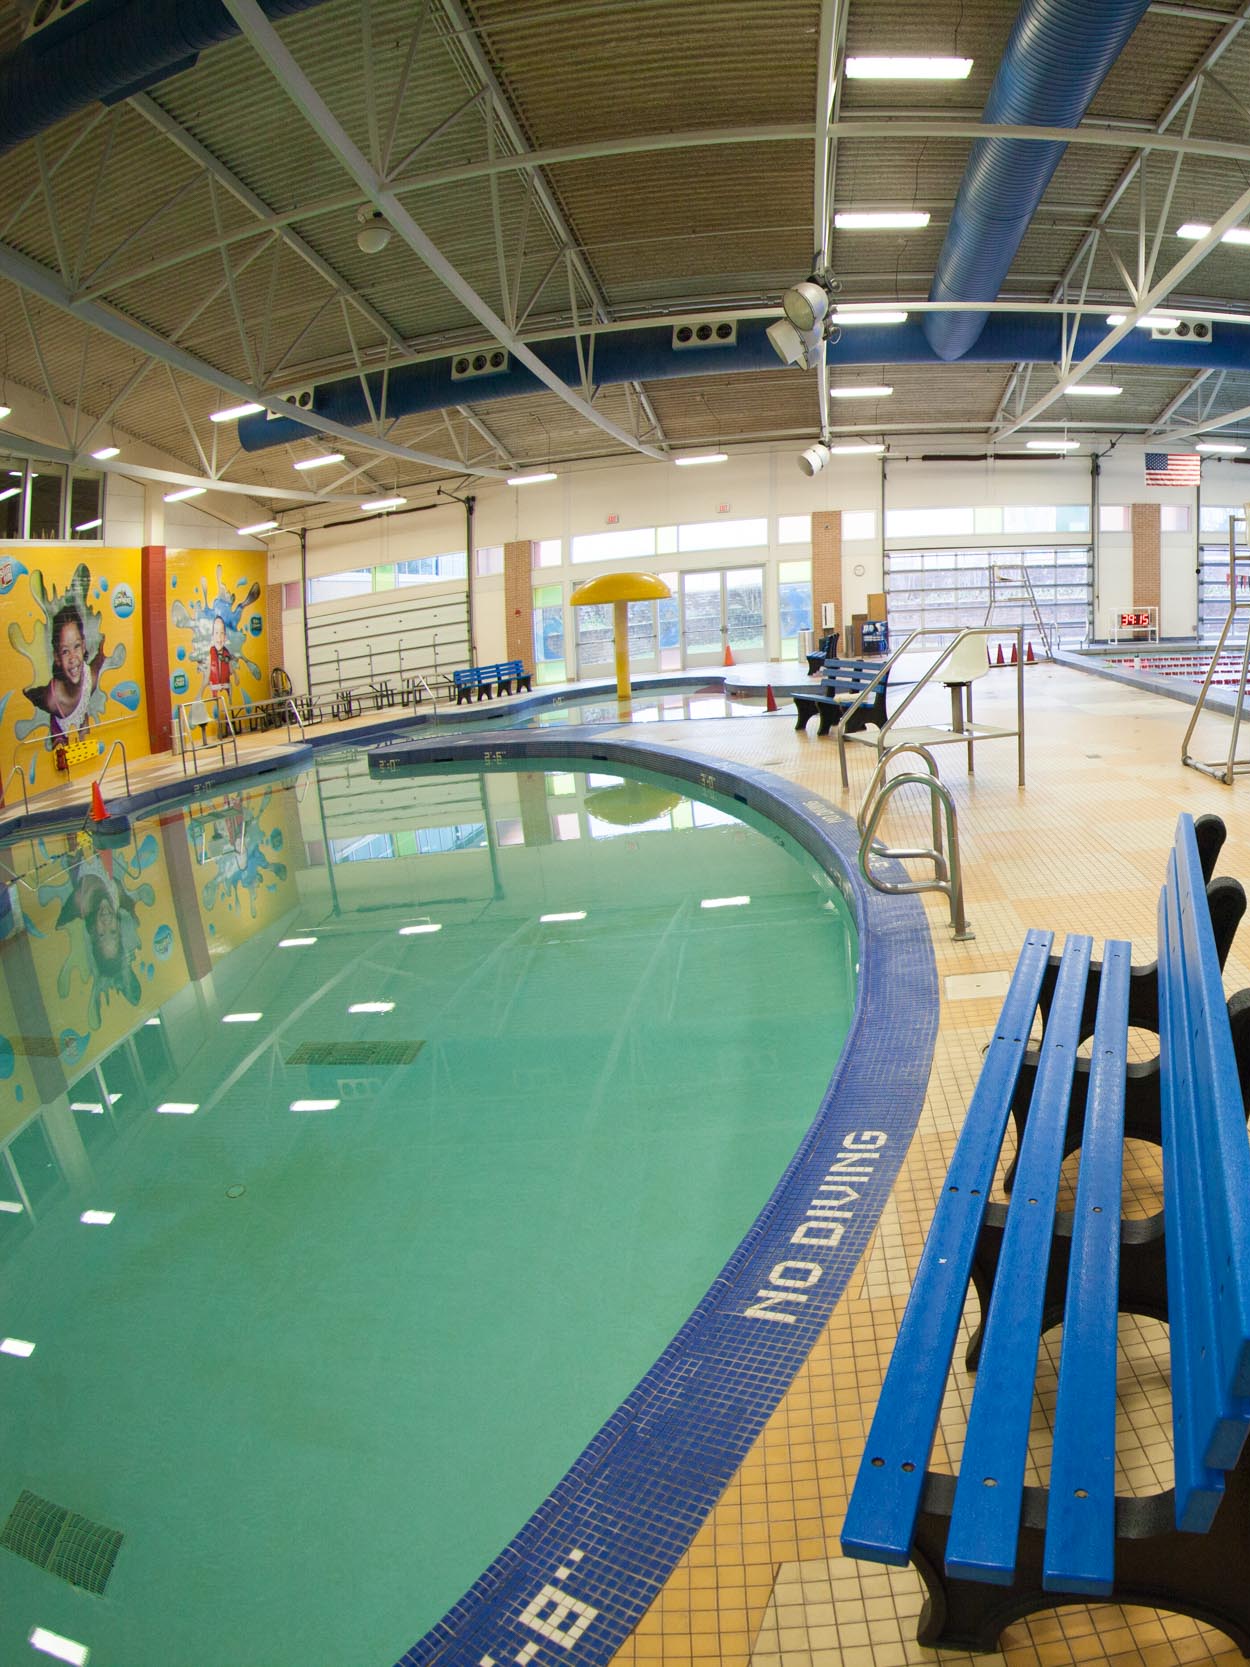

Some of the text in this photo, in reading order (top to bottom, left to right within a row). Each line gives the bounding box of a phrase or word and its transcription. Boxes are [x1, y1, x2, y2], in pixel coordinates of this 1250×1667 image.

[1122, 614, 1149, 626] 39:15
[743, 1130, 888, 1324] NO DIVING
